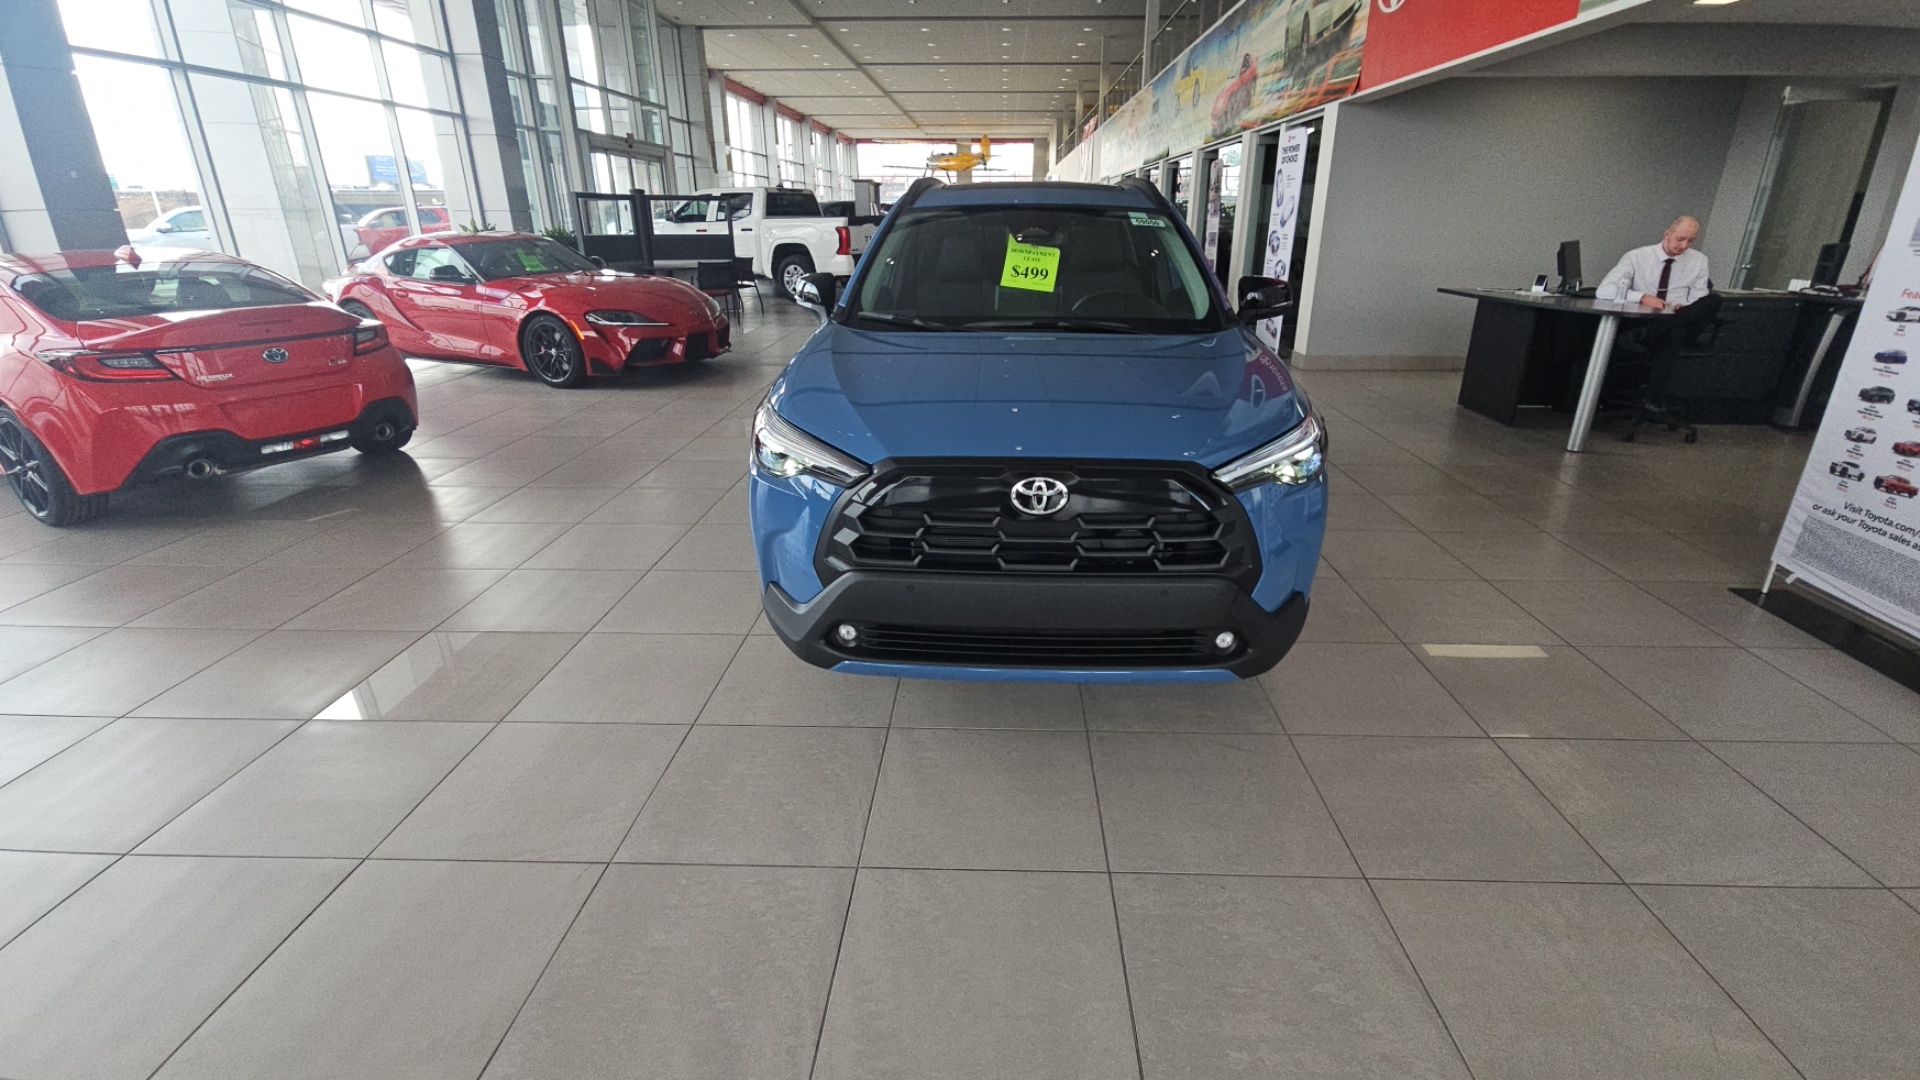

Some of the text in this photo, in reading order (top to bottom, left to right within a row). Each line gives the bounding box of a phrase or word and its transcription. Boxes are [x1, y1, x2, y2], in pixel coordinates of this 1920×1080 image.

[1011, 248, 1056, 257] DOWNPAYMENT
[1010, 265, 1049, 281] $499
[1843, 501, 1863, 515] Visit
[1822, 507, 1837, 517] ask
[1835, 513, 1857, 525] your
[1857, 519, 1888, 537] Toyota
[1888, 532, 1912, 547] sales
